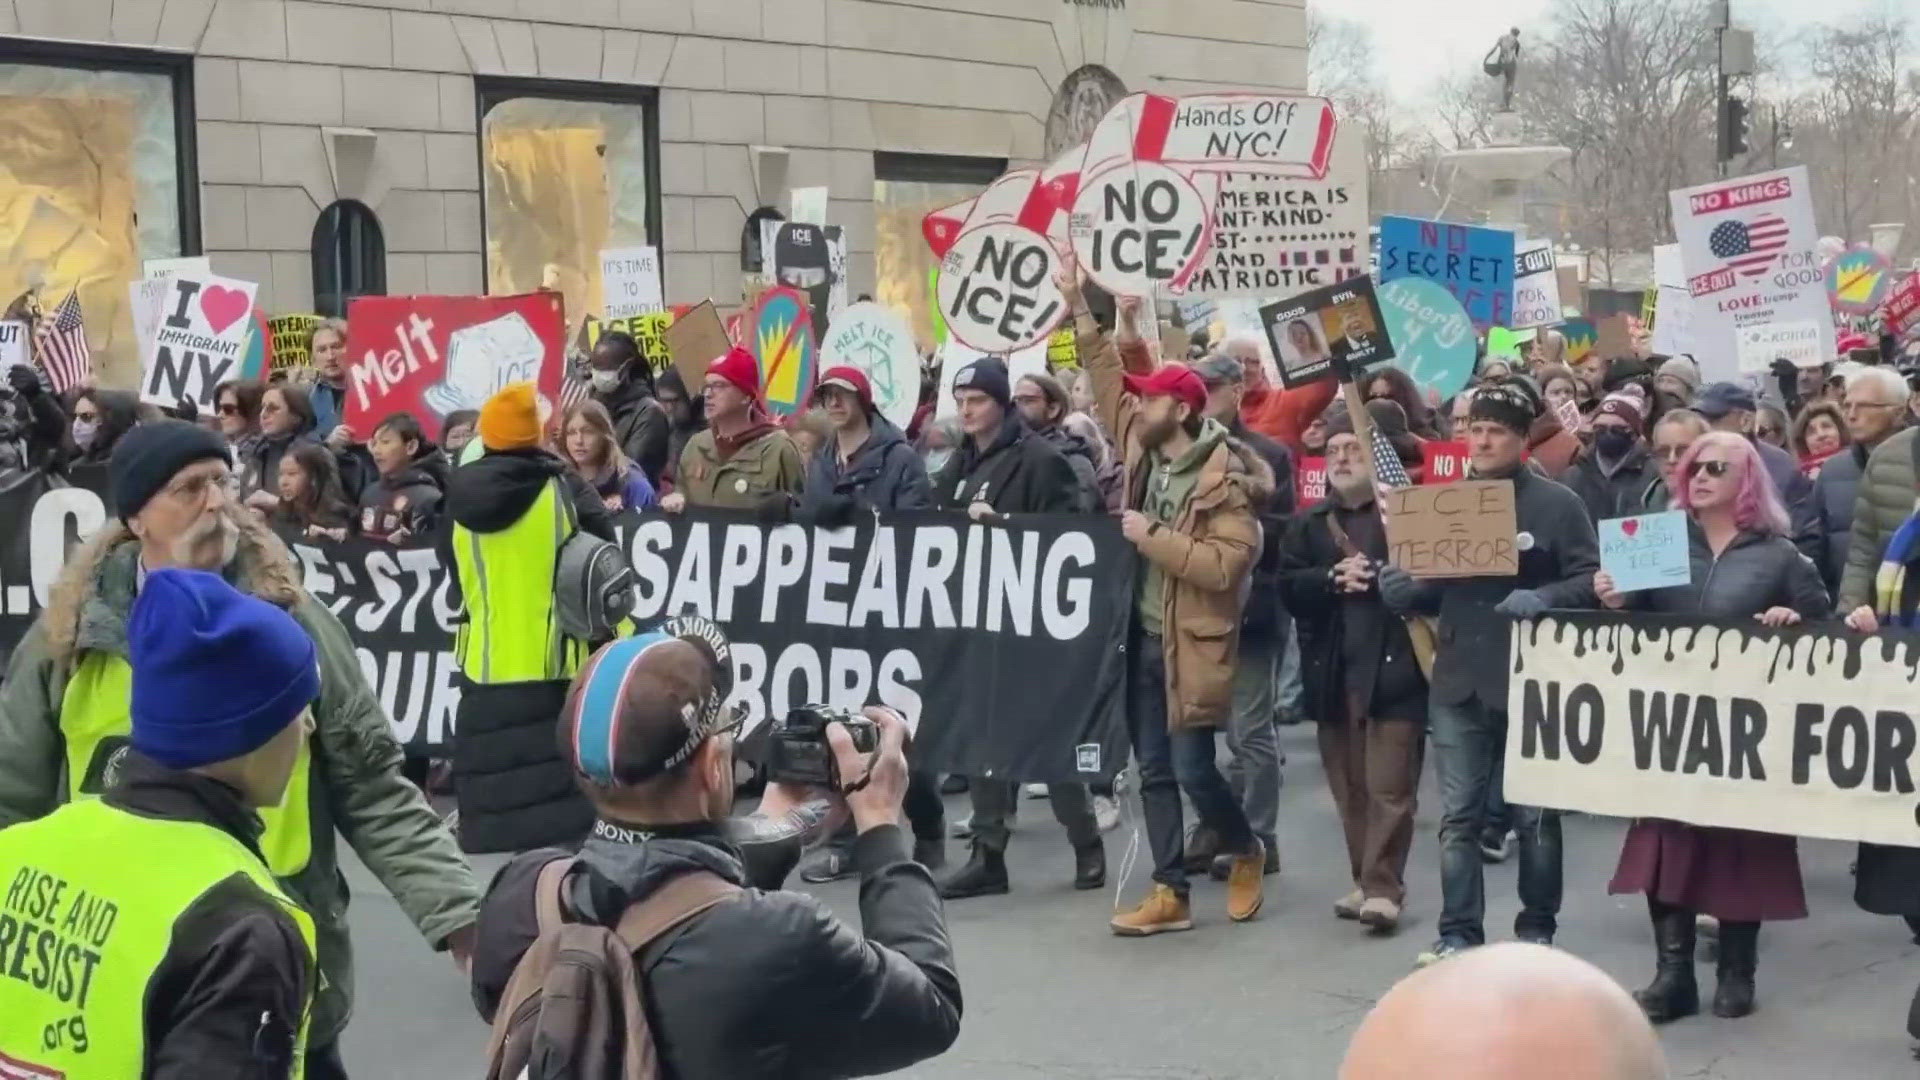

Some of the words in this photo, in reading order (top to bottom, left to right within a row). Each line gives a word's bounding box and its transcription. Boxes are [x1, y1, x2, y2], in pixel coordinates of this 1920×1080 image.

[1175, 102, 1245, 128] Hands
[1254, 100, 1298, 125] Off
[1205, 128, 1288, 159] NYC!
[1104, 179, 1180, 224] NO
[1216, 190, 1317, 208] MERICA
[1327, 187, 1348, 204] IS
[1690, 194, 1721, 211] NO
[1728, 180, 1790, 206] KINGS
[792, 229, 812, 242] ICE
[1092, 222, 1203, 279] ICE!
[1420, 222, 1467, 253] NO
[626, 257, 652, 275] TIME
[974, 235, 1049, 289] NO
[1215, 252, 1265, 267] AND
[1386, 246, 1503, 284] SECRET
[1525, 251, 1552, 270] OUT
[1781, 250, 1813, 269] FOR
[623, 281, 638, 296] TO
[1774, 269, 1823, 288] GOOD
[166, 279, 201, 329] I
[949, 275, 1060, 341] ICE!
[1275, 306, 1306, 321] GOOD
[1718, 293, 1762, 312] LOVE
[651, 317, 667, 335] IS
[834, 321, 866, 353] MELT
[871, 326, 895, 349] ICE
[158, 329, 240, 355] IMMIGRANT
[150, 346, 233, 406] NY
[351, 312, 439, 412] Melt
[497, 360, 535, 387] ICE
[1433, 455, 1454, 477] NO
[1394, 485, 1505, 515] ICE
[1393, 537, 1516, 570] TERROR
[614, 520, 1096, 641] SAPPEARING
[1521, 679, 1605, 764] NO
[1629, 688, 1767, 781] WAR
[1792, 703, 1916, 793] FOR
[594, 819, 656, 843] SONY
[5, 866, 67, 924] RISE
[61, 889, 118, 947] AND
[0, 913, 101, 1010] RESIST
